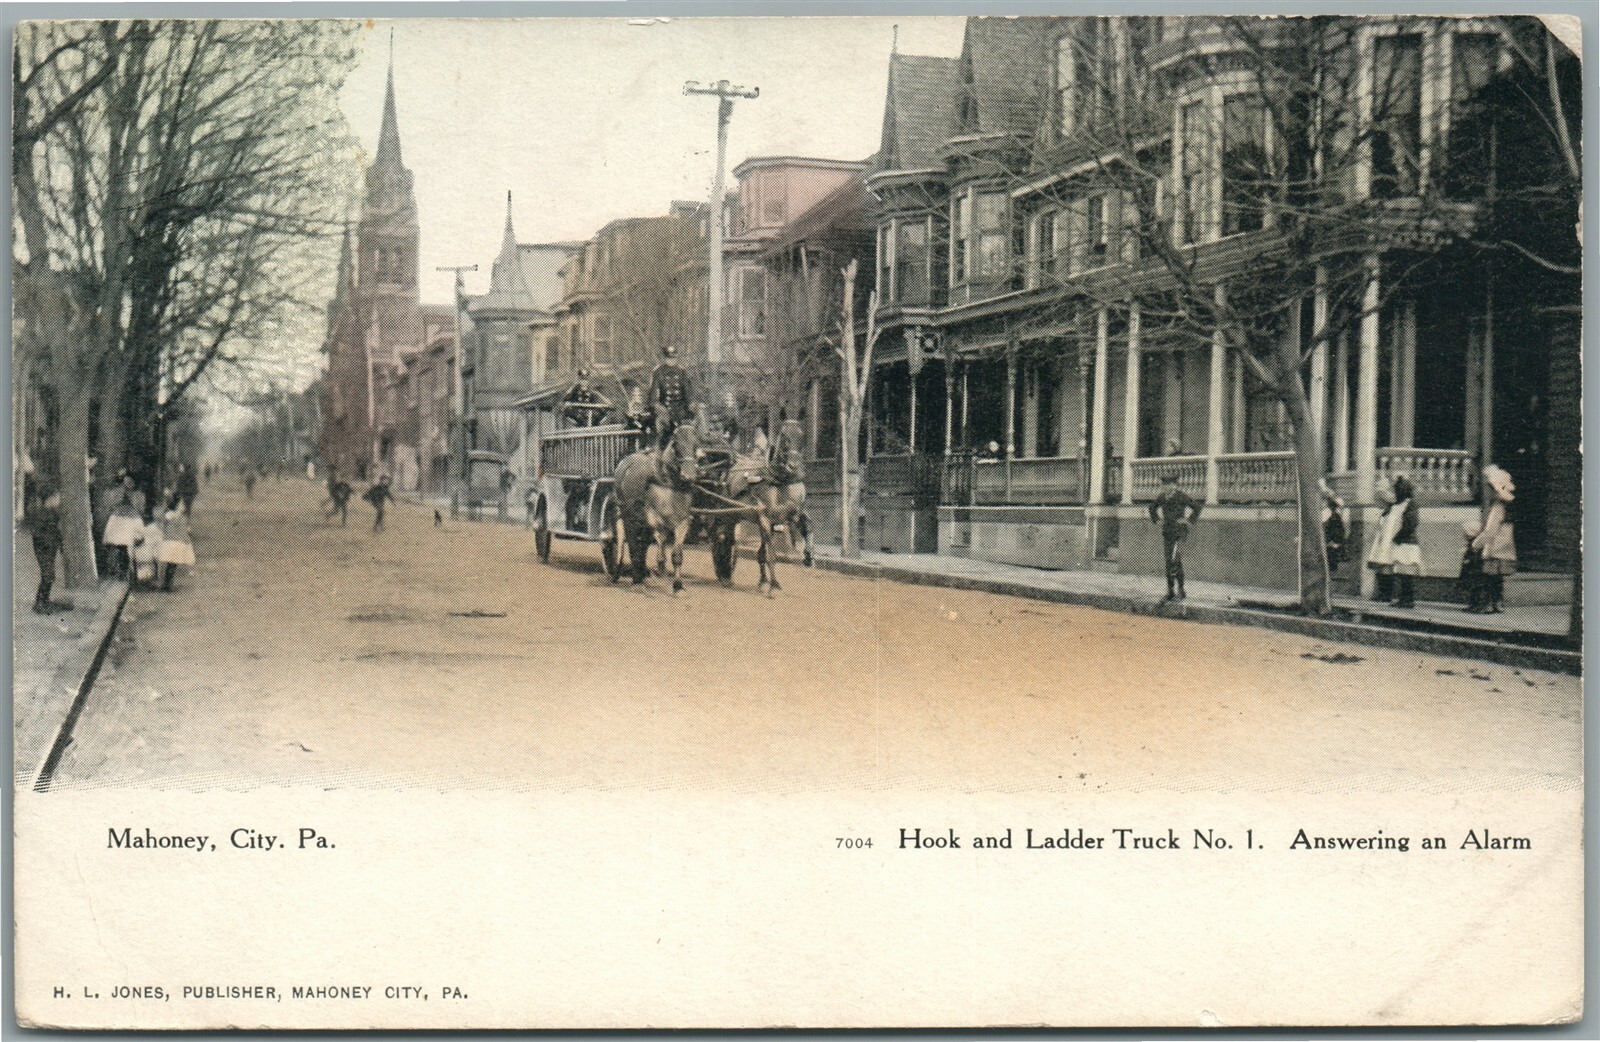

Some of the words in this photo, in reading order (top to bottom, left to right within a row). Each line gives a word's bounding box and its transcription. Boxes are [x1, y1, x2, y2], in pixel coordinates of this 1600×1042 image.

[107, 827, 216, 853] Mahoney,
[230, 828, 285, 852] City.
[298, 827, 336, 849] Pa.
[835, 837, 874, 849] 7004
[899, 828, 961, 849] Hook
[972, 828, 1013, 849] and
[1026, 828, 1105, 849] Ladder
[1112, 828, 1181, 850] Truck
[1193, 828, 1233, 850] No.
[1246, 829, 1264, 850] 1.
[1289, 828, 1410, 853] Answering
[1421, 837, 1447, 850] an
[1459, 828, 1532, 850] Alarm
[53, 986, 71, 999] H.
[84, 986, 99, 999] L.
[111, 985, 170, 1002] JONES,
[183, 986, 281, 1003] PUBLISHER,
[292, 986, 372, 999] MAHONEY
[385, 986, 428, 1002] CITY,
[442, 986, 468, 999] PA.
